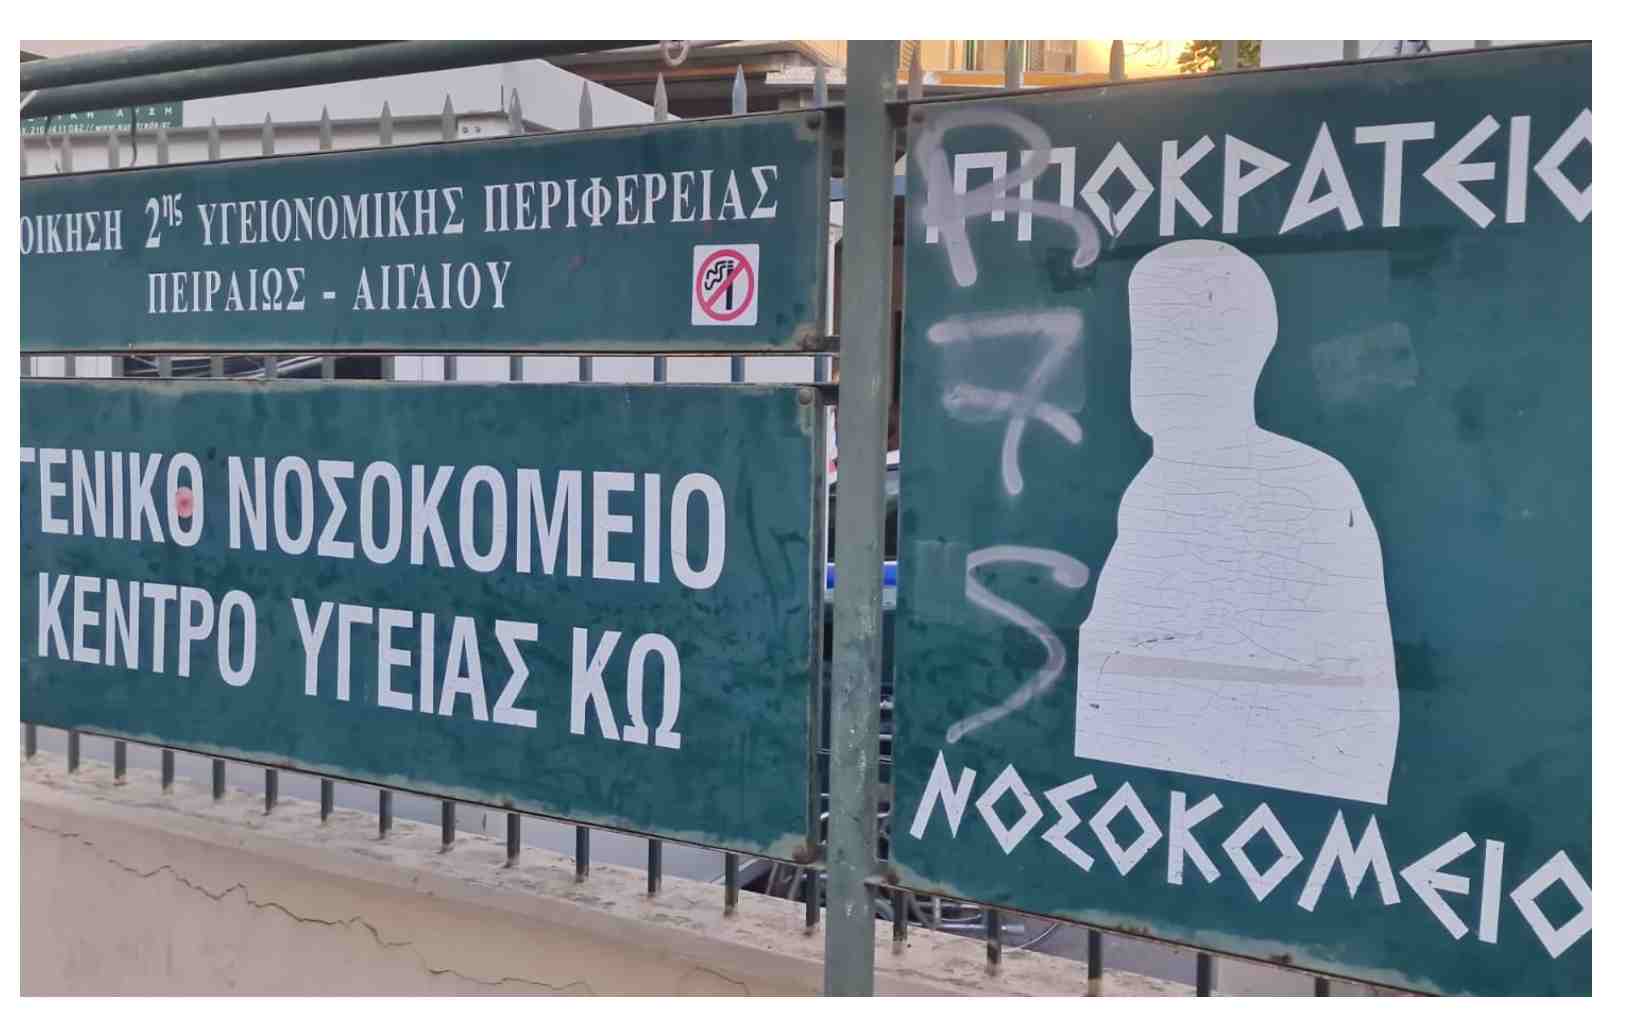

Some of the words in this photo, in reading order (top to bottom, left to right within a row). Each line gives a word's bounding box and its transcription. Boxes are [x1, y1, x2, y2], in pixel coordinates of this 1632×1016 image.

[198, 186, 465, 246] ΥΓΕΙΟΝΟΜΙΚΗΣ
[482, 165, 778, 233] ΠΕΡΙΦΕΡΕΙΑΣ
[147, 266, 307, 314] ΠΕΙΡΑΙΩΣ
[352, 260, 512, 312] ΑΙΓΑΙΟΥ
[228, 455, 725, 590] ΝΟΣΟΚΟΜΕΙΟ
[38, 572, 256, 687] ΚΕΝΤΡΟ
[291, 597, 538, 729] ΥΓΕΙΑΣ
[570, 626, 683, 749] ΚΩ
[909, 750, 1592, 960] ΝΟΣΟΚΟΜΕΙΟ
